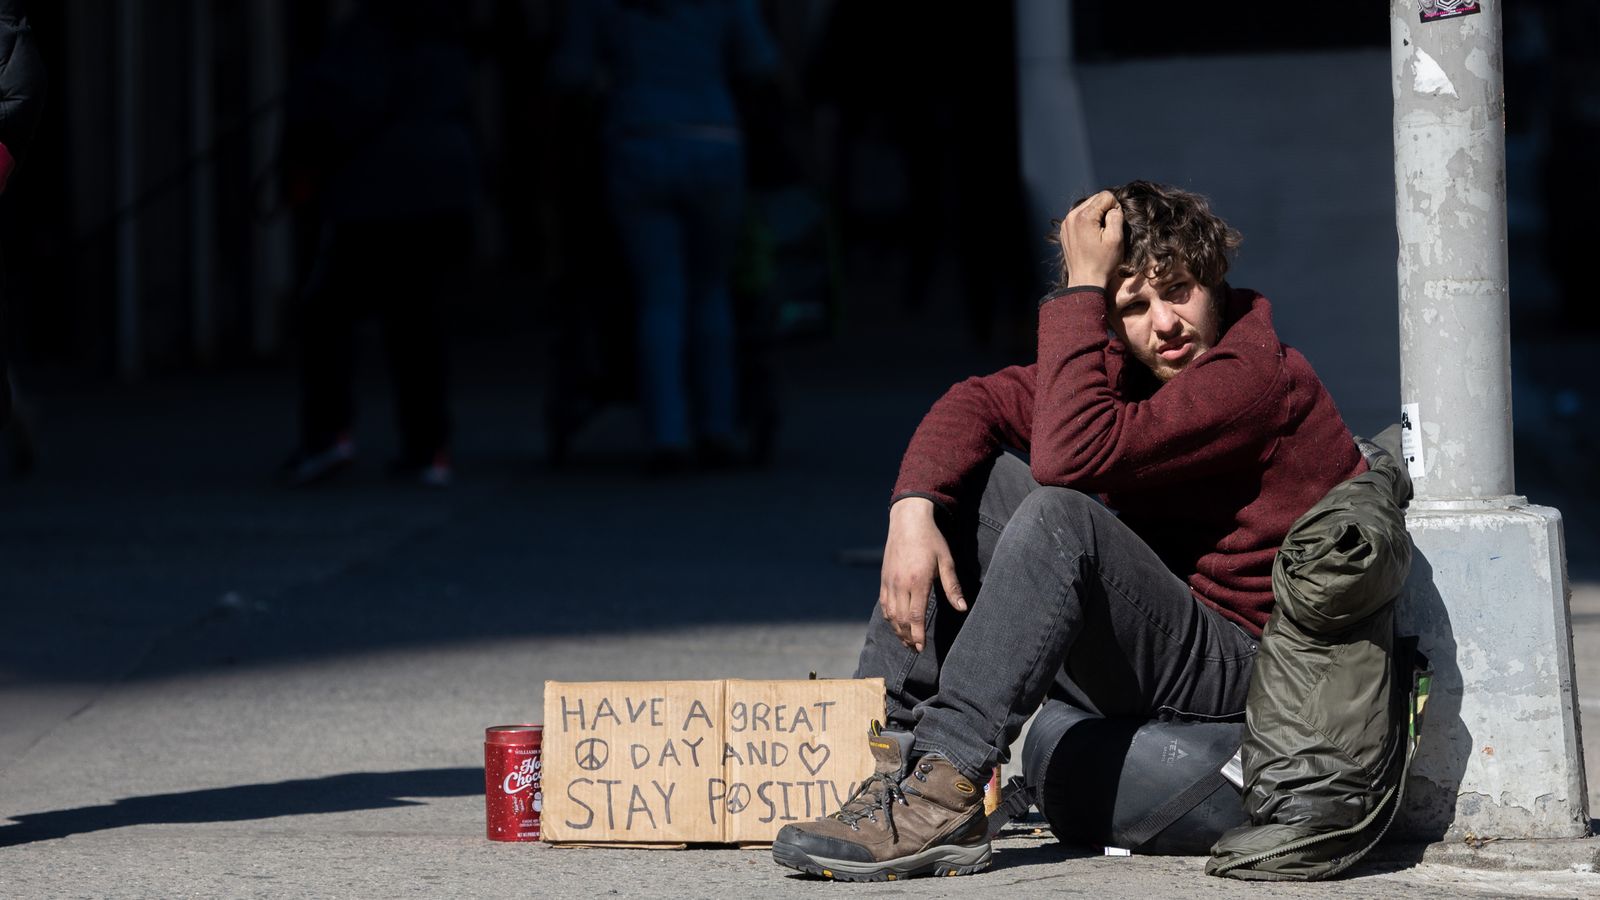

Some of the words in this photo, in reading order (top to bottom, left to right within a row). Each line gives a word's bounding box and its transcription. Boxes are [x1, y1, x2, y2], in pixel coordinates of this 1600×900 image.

[561, 696, 665, 732] HAVE
[682, 700, 713, 731] A
[520, 756, 542, 775] Ho
[631, 737, 704, 769] DAY
[722, 740, 789, 767] AND
[565, 777, 676, 831] STAY
[708, 777, 857, 825] POSITIV
